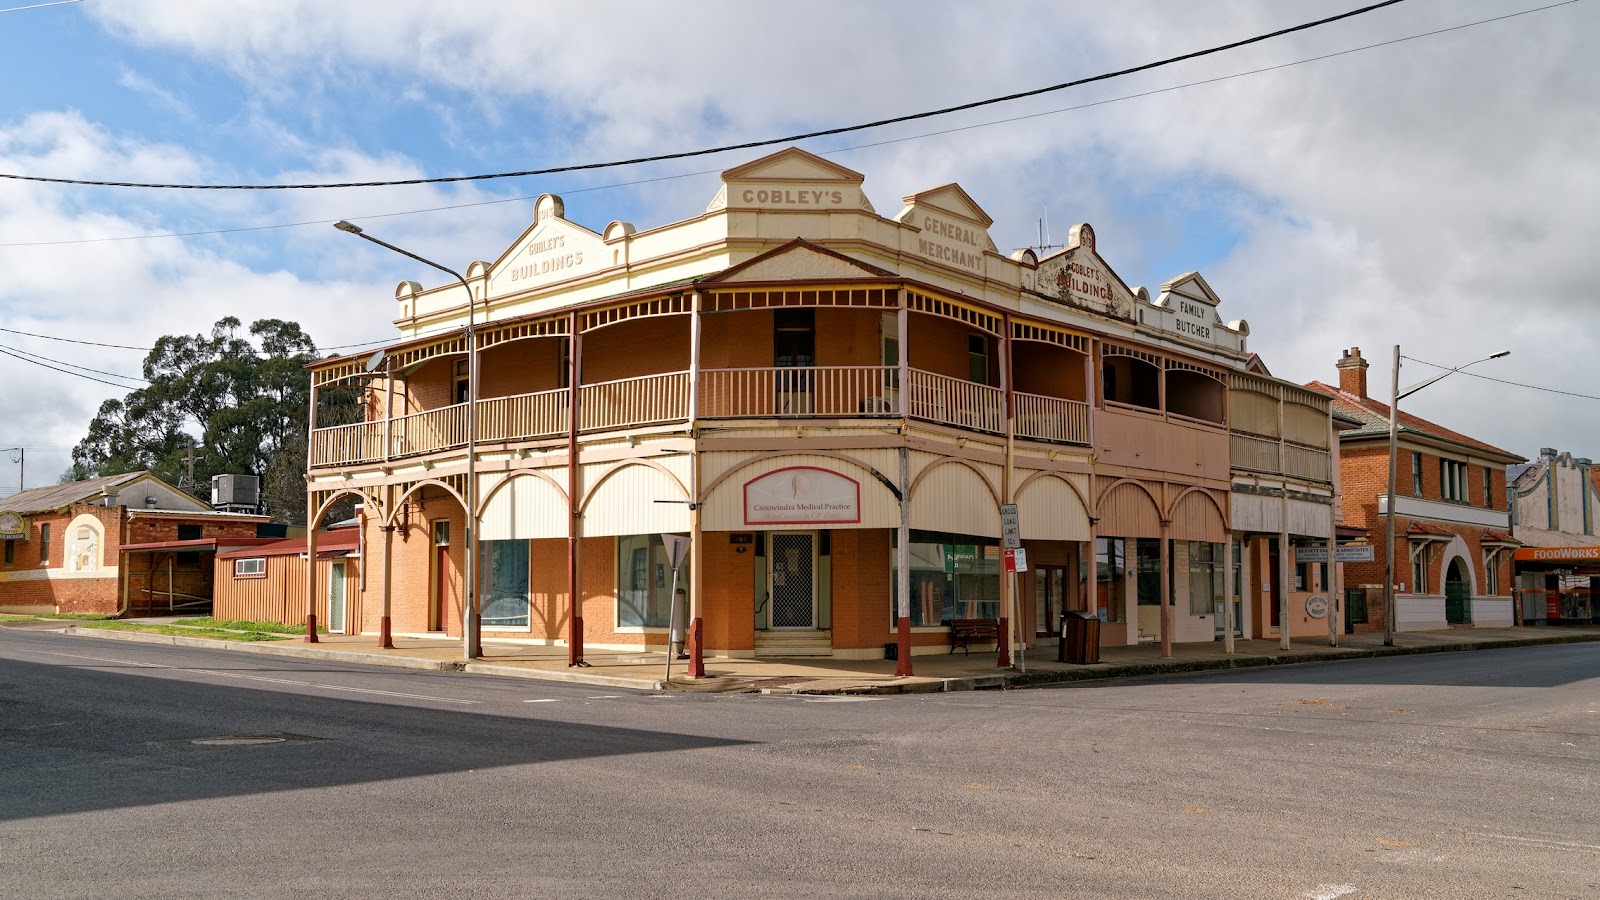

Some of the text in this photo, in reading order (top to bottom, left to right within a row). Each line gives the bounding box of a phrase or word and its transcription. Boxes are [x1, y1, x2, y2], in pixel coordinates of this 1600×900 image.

[743, 189, 843, 205] COBLEY'S
[924, 216, 977, 247] GENERAL
[528, 235, 565, 256] COBLEY'S
[919, 238, 982, 271] MERCHANT
[511, 251, 583, 282] BUILDINGS
[1180, 300, 1205, 320] FAMILY
[1176, 318, 1210, 340] BUTCHER
[753, 503, 851, 512] Canowindra Medical Practice
[1533, 548, 1599, 560] FOODWORKS
